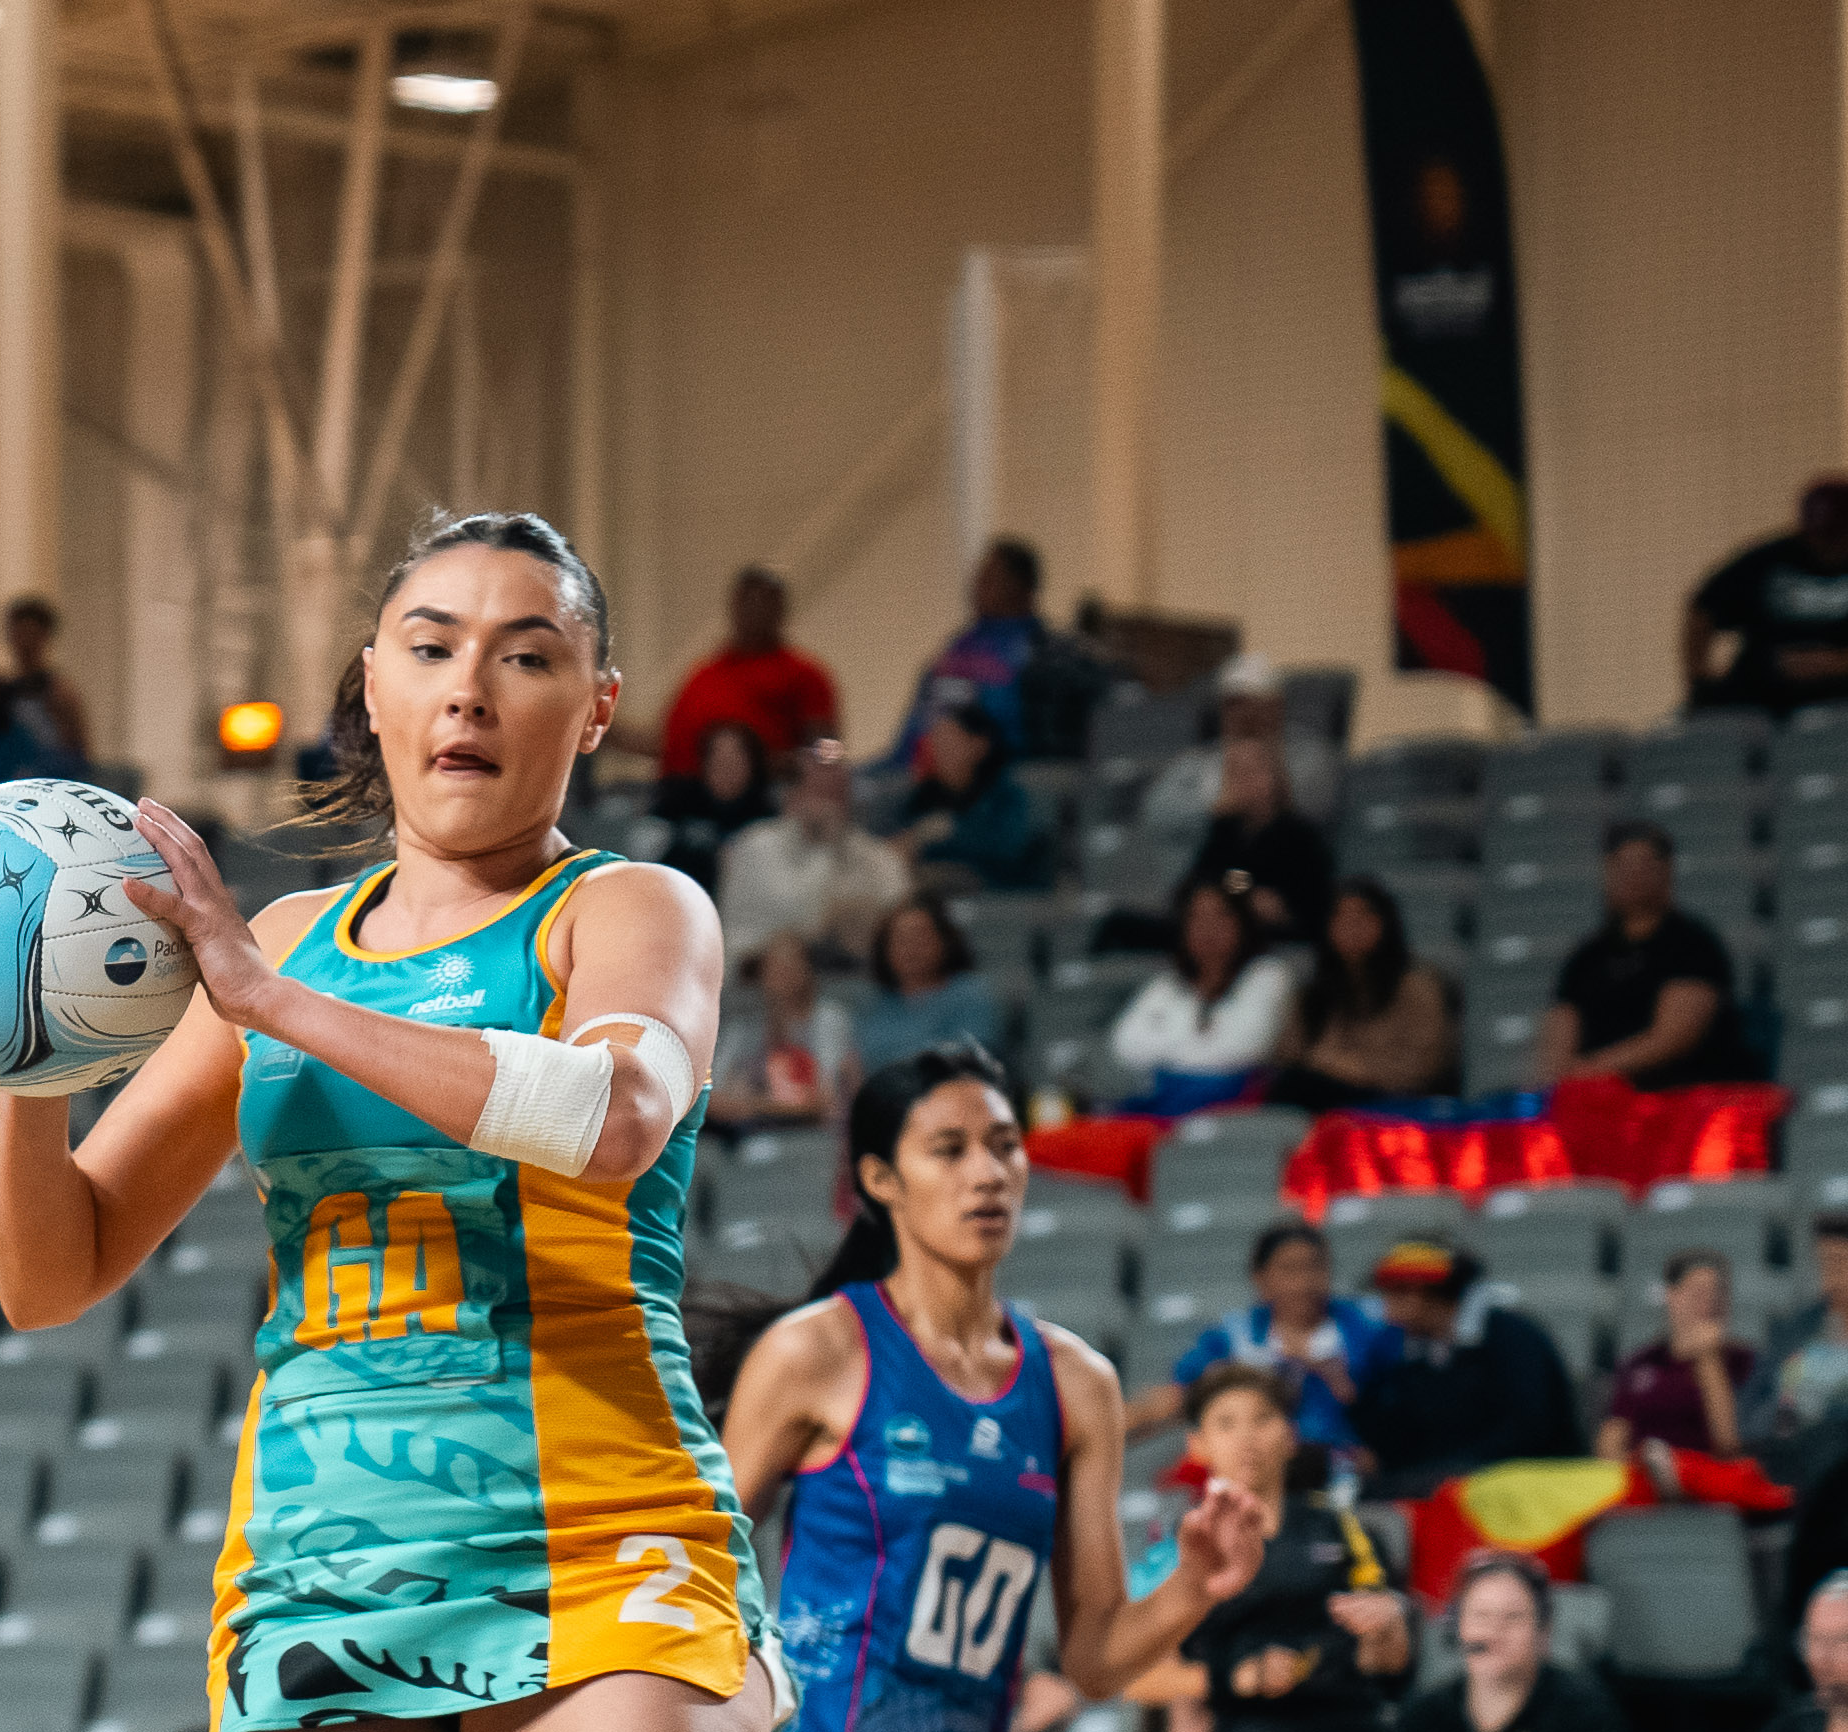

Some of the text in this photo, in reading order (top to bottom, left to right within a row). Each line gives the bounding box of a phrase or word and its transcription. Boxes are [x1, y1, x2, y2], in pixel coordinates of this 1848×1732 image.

[407, 989, 486, 1016] netball
[293, 1190, 465, 1351] GA
[615, 1534, 695, 1632] 2
